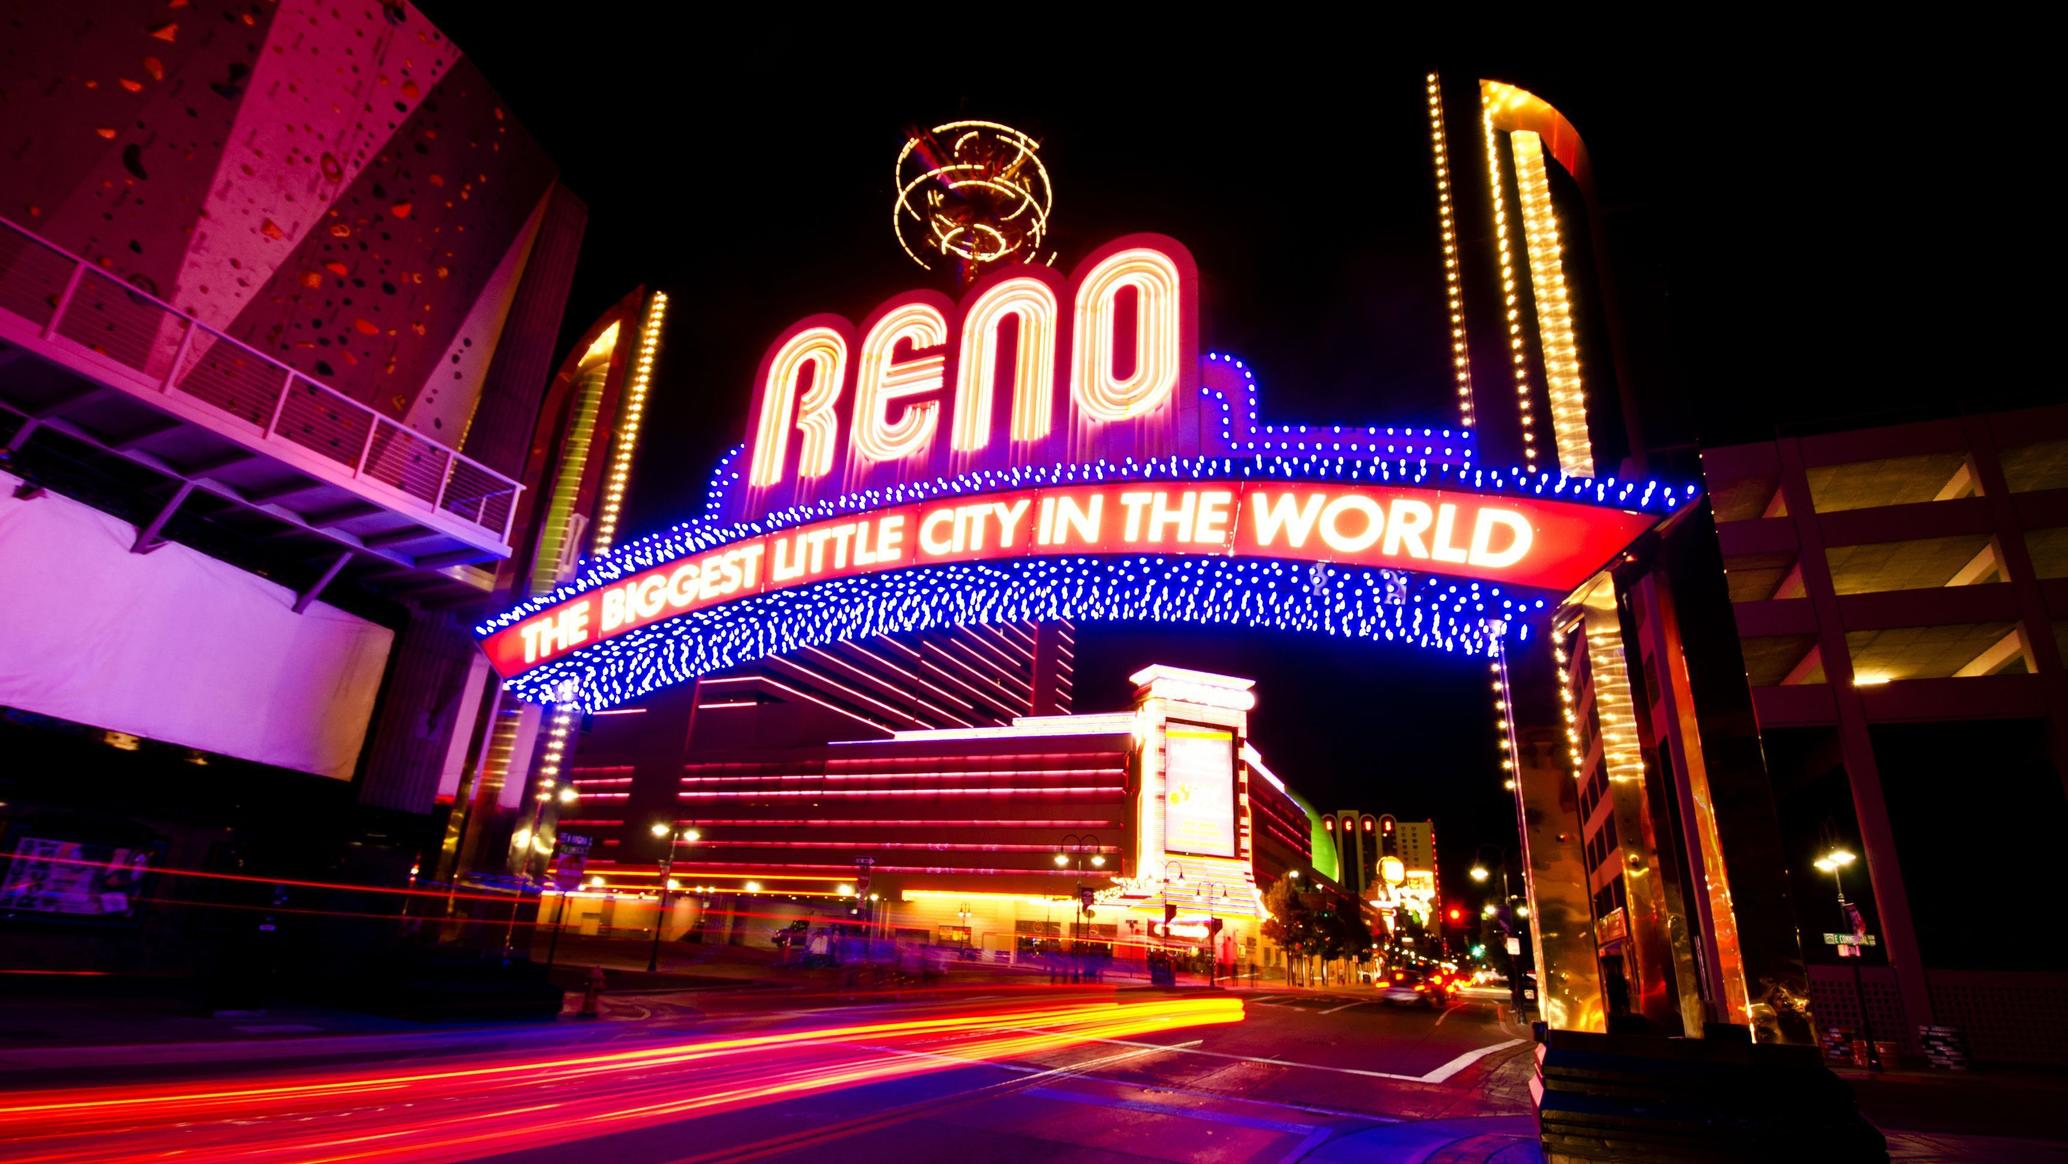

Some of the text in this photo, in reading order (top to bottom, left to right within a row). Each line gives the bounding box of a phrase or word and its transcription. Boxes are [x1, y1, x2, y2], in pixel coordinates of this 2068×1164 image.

[749, 247, 1181, 487] RENO
[521, 491, 1534, 664] THE BIGGEST LITTLE CITY IN THE WORLD
